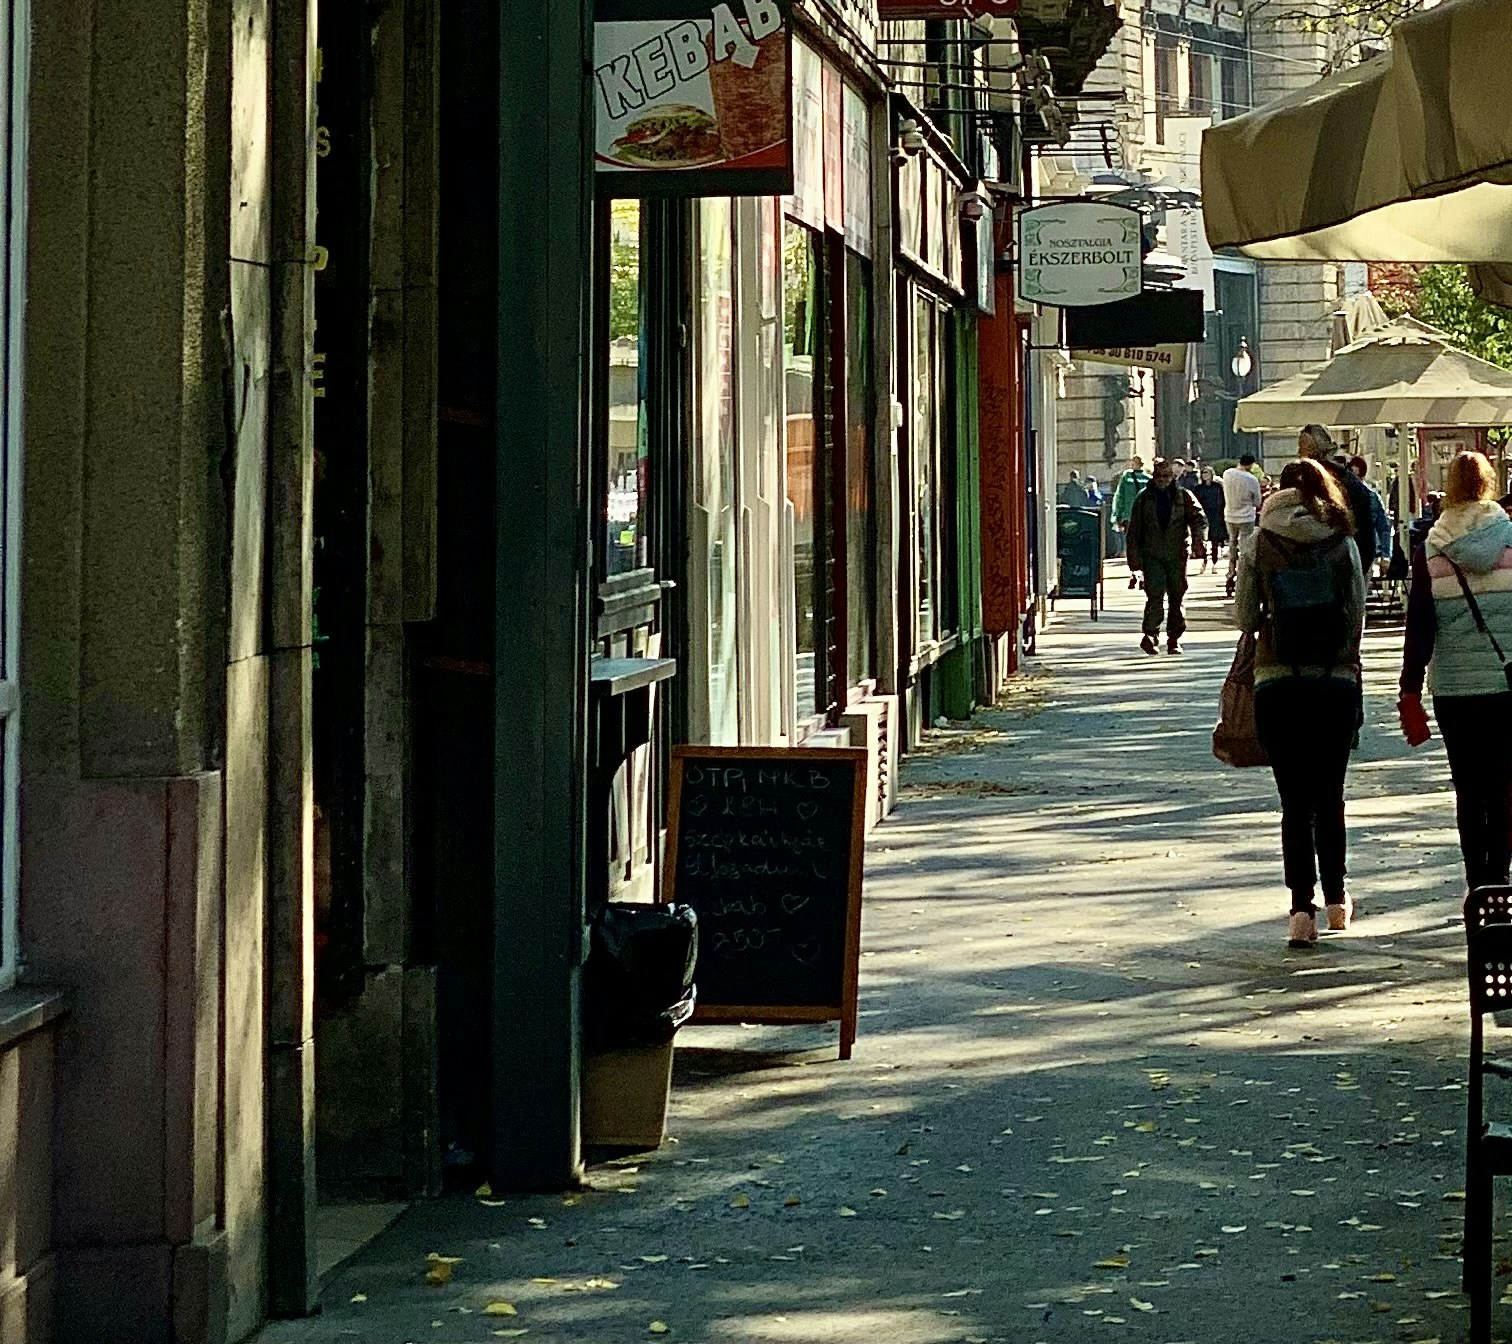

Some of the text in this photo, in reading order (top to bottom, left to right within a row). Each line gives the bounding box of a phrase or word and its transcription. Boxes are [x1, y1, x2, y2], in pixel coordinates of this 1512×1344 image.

[1049, 238, 1112, 248] NOSZTALGIA
[1029, 248, 1134, 266] ÉKSZERBOLT
[1145, 350, 1172, 365] 5744
